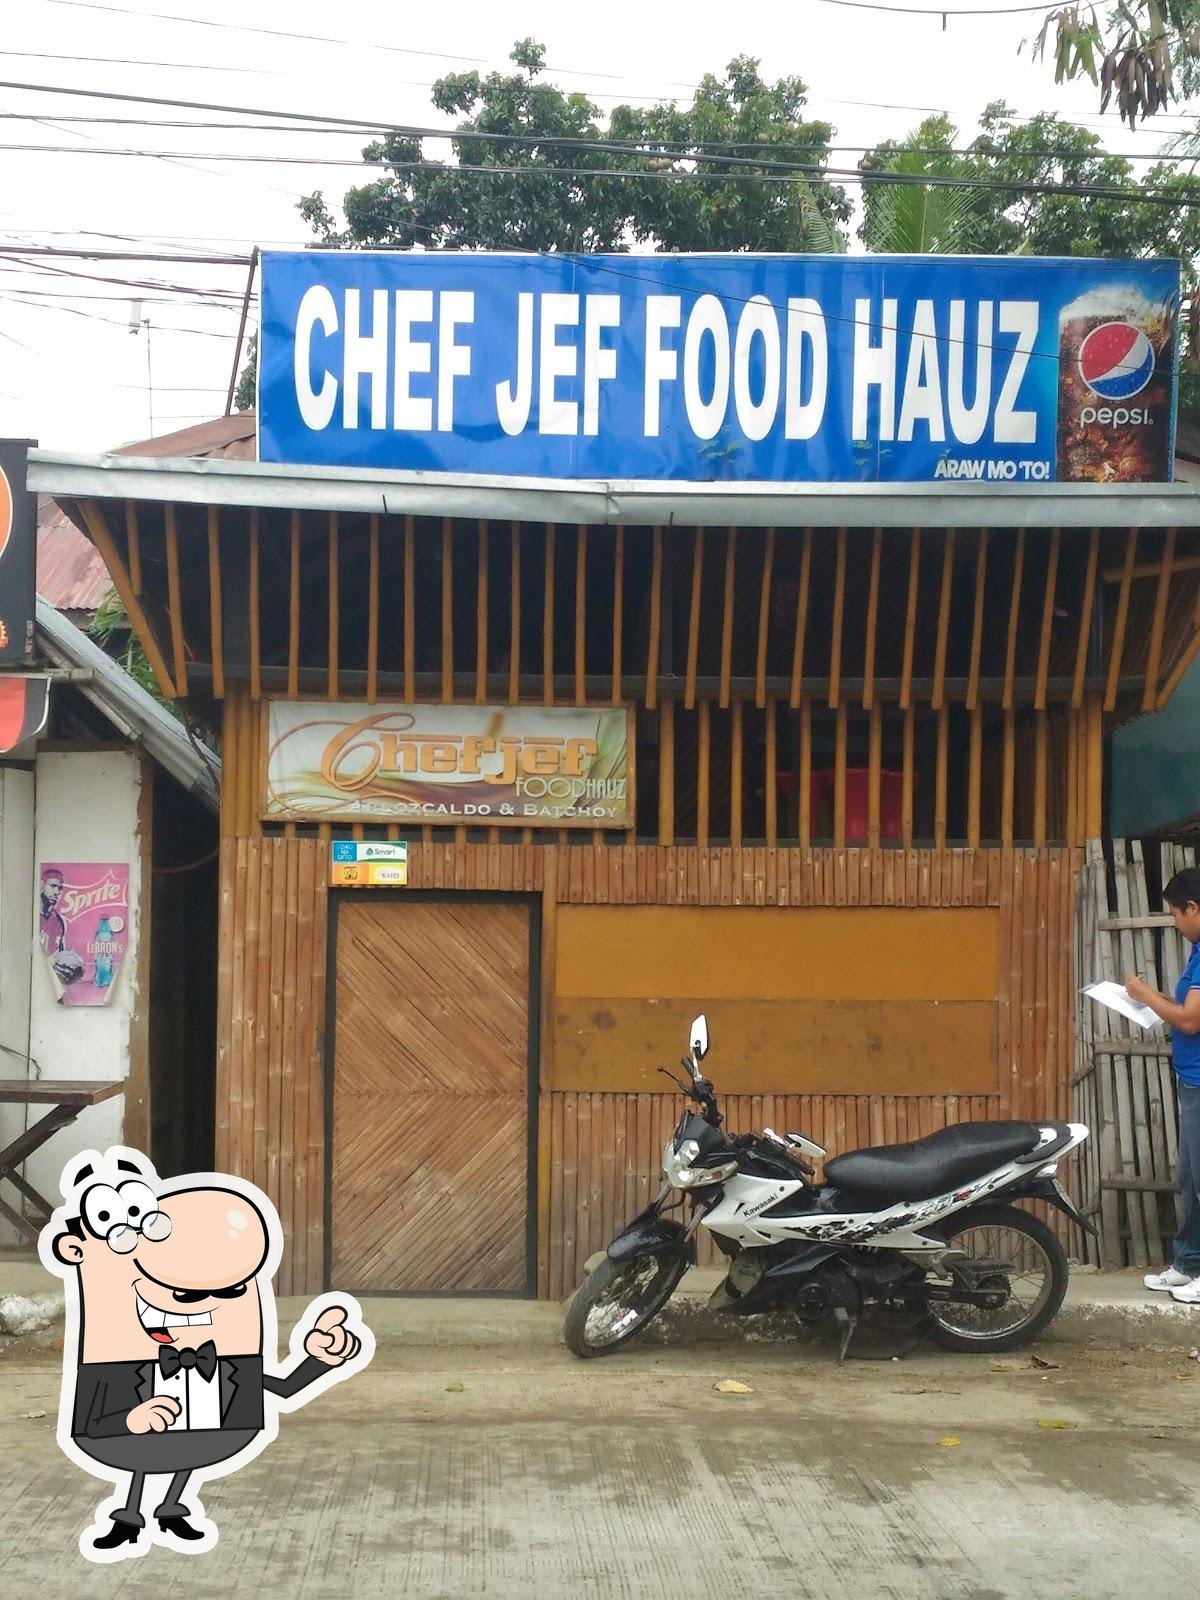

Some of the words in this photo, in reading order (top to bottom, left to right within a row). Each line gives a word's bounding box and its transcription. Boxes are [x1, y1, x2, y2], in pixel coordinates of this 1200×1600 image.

[294, 285, 474, 431] CHEF
[495, 292, 621, 436] JEF
[643, 294, 828, 442] FOOD
[852, 298, 1039, 444] HAUZ
[1080, 406, 1149, 429] pepsi
[934, 459, 985, 478] ARAW
[987, 461, 1017, 479] MO
[499, 803, 514, 815] &
[60, 879, 121, 915] Sprite
[743, 1193, 778, 1217] Kawasaki
